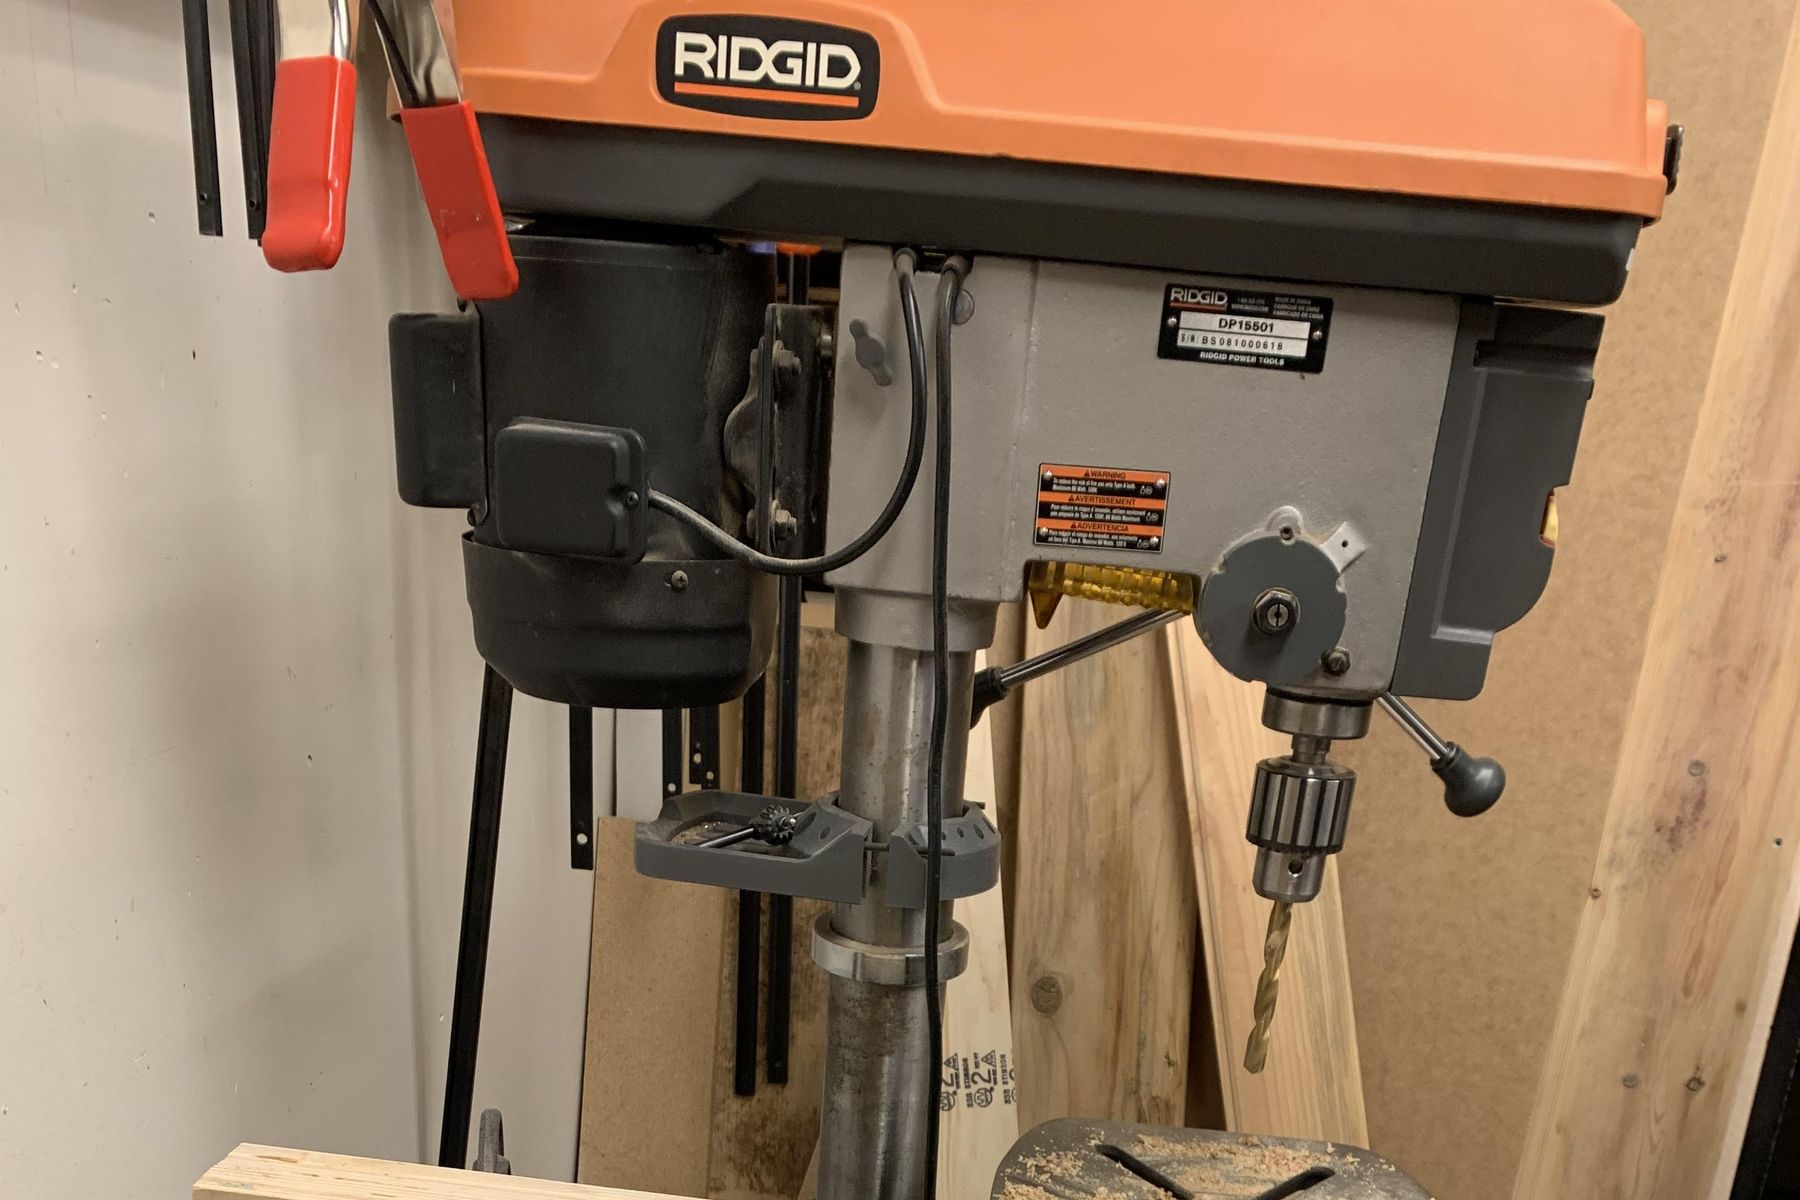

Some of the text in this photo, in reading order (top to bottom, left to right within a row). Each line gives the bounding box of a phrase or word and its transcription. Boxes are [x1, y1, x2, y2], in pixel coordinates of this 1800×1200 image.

[674, 31, 861, 89] RIDGID
[1170, 287, 1228, 305] RIDGID
[1218, 318, 1274, 333] DP15501
[1200, 352, 1285, 366] RIDGID POWER TOOLS
[1090, 470, 1126, 480] WARNING
[1075, 496, 1136, 506] AVERTISSEMENT
[1076, 521, 1129, 532] ADVERTENCIA
[971, 1068, 992, 1085] 2
